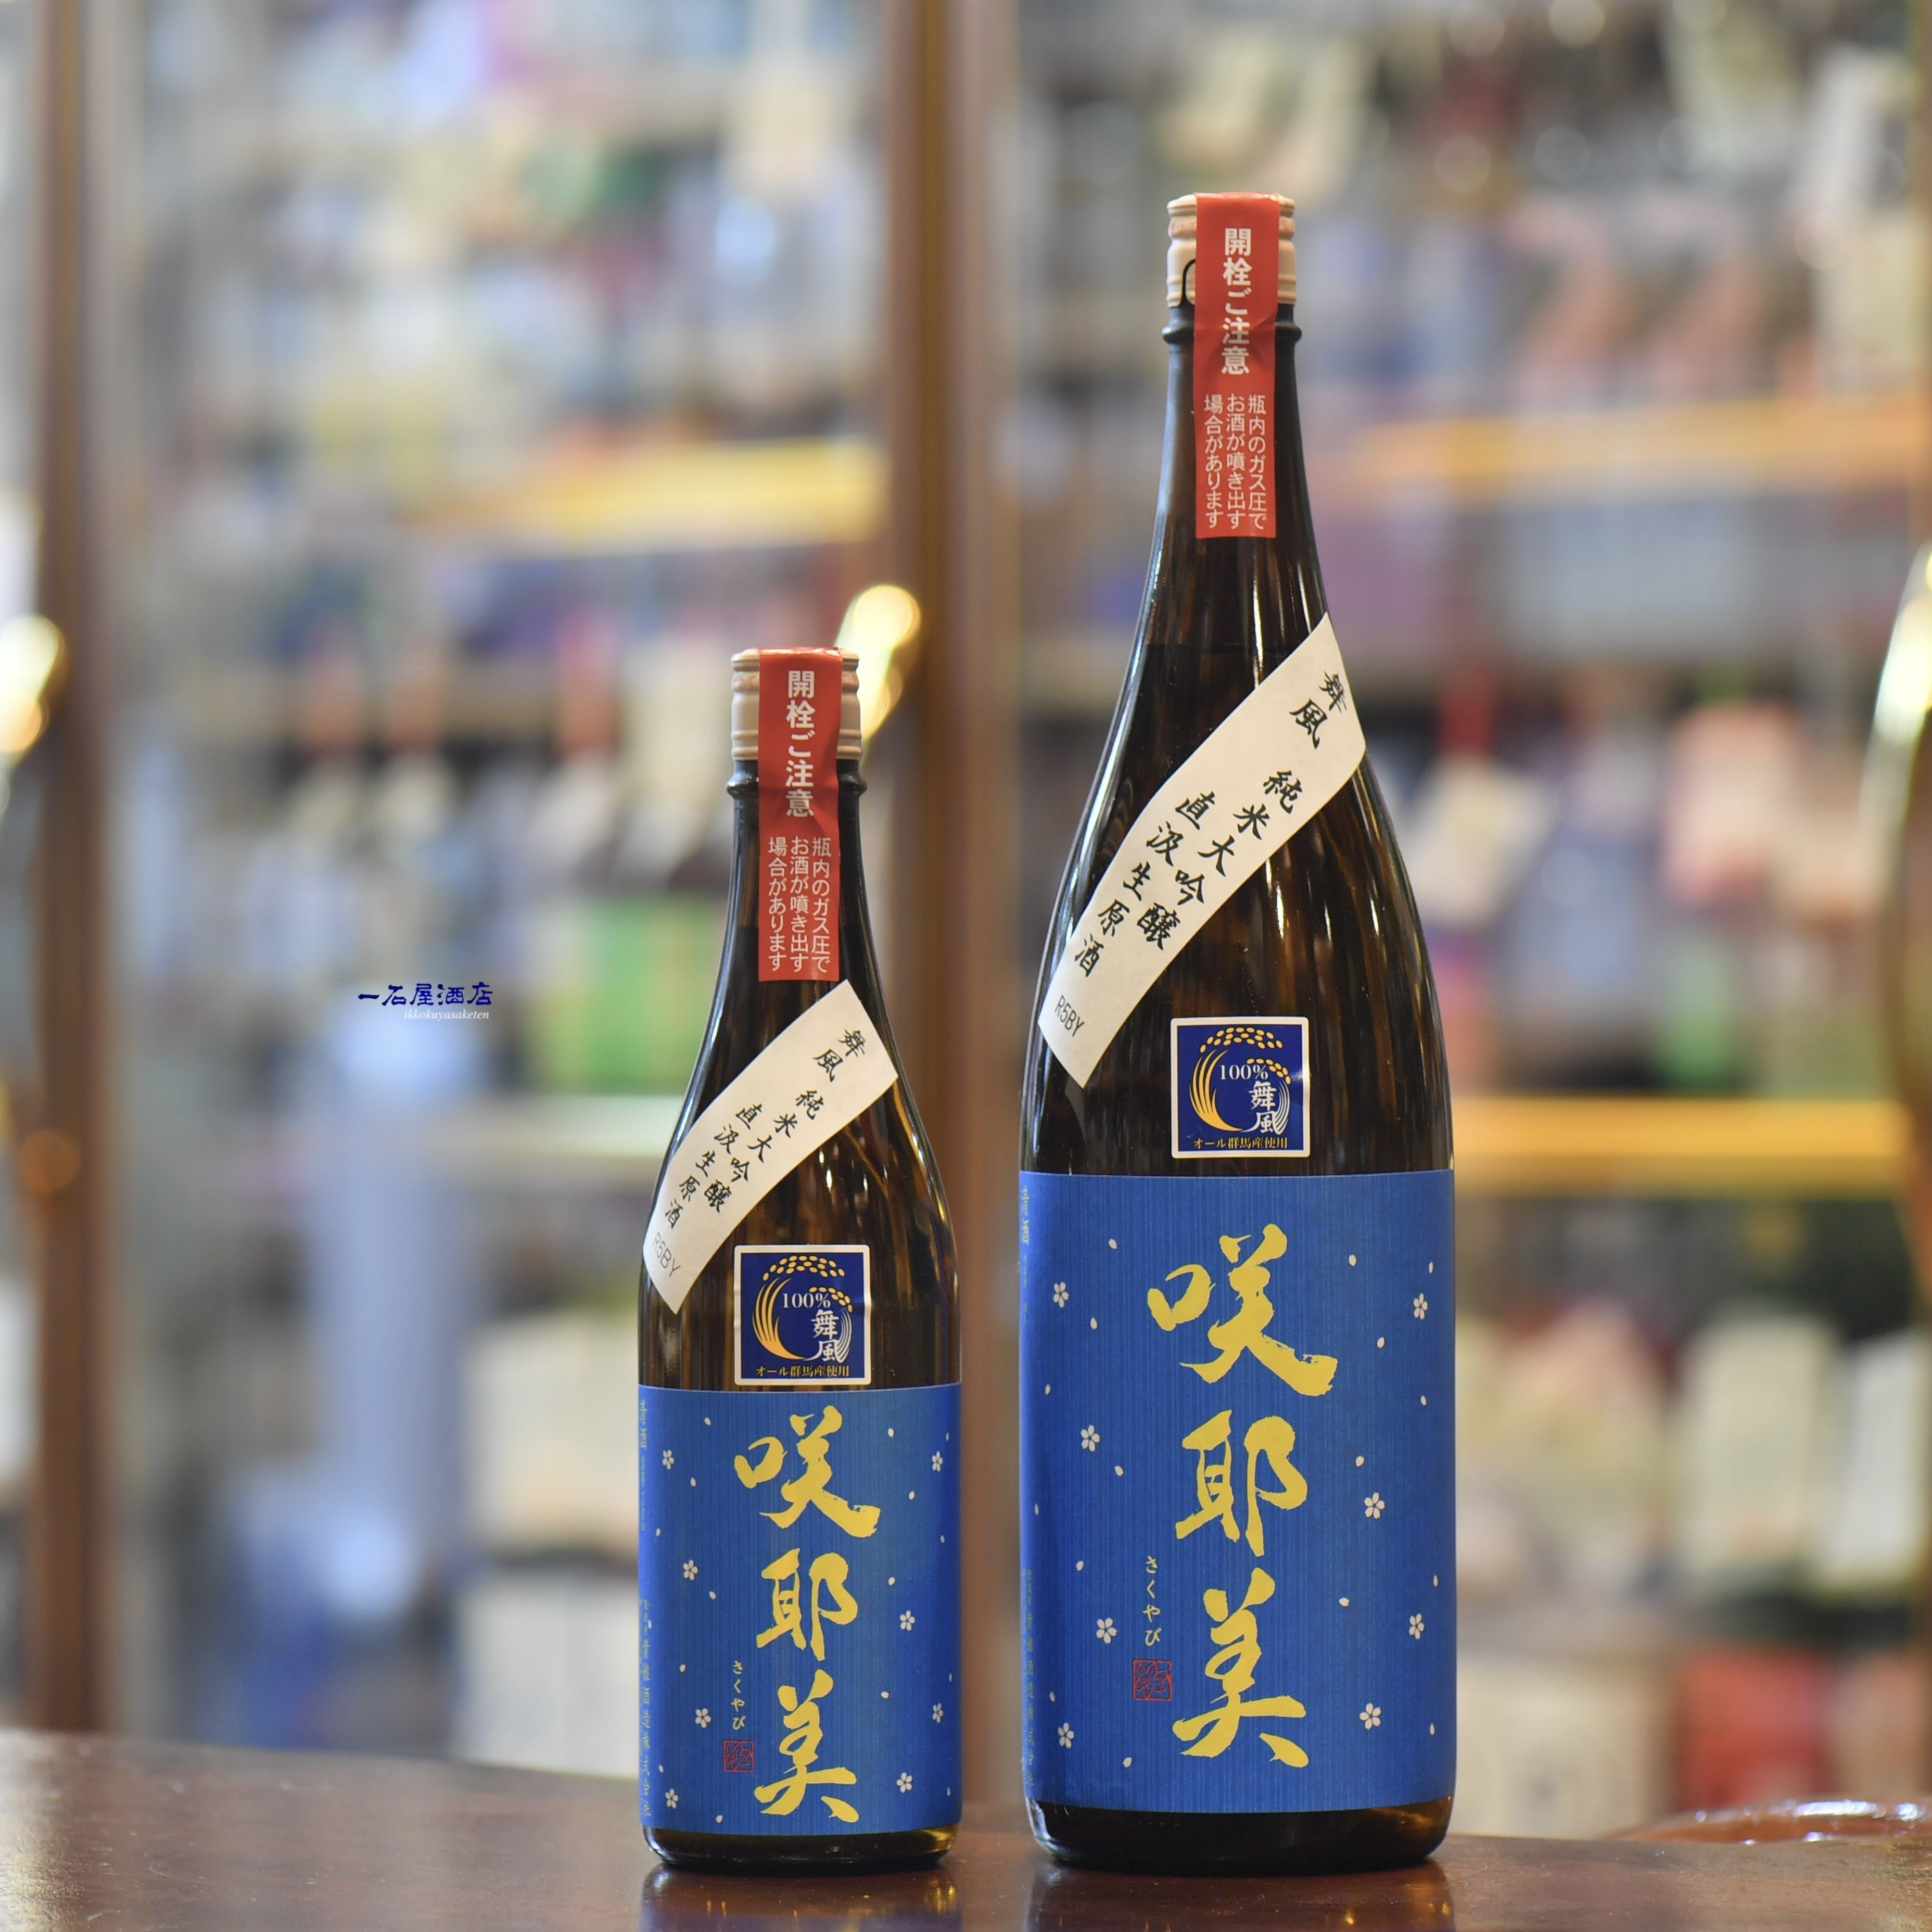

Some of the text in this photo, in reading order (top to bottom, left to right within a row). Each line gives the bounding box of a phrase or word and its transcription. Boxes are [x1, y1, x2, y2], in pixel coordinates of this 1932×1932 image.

[1221, 227, 1253, 375] 開栓ご注意
[1204, 394, 1224, 529] 場合があります
[1226, 393, 1245, 529] お酒が噴き出す
[1248, 394, 1267, 530] 瓶内のガス圧で
[785, 670, 816, 817] 開栓ご注意
[1136, 671, 1349, 951] 舞風 純米大吟醸
[768, 836, 787, 972] 場合があります
[790, 836, 809, 973] お酒が噴き出す
[811, 837, 832, 974] 瓶内のガス圧で
[1074, 791, 1215, 978] 直汲生原酒
[1054, 995, 1085, 1037] R5BY
[1220, 1064, 1268, 1080] 100%
[665, 1103, 763, 1229] 直汲生原酒
[704, 1029, 866, 1213] 舞風 純米大吟醸
[1193, 1137, 1288, 1149] オール群馬産使用
[1248, 1081, 1280, 1135] 舞風
[653, 1232, 681, 1279] R5BY
[783, 1293, 831, 1308] 100%
[756, 1365, 849, 1377] オール群馬産使用
[810, 1309, 842, 1363] 舞風
[1148, 1225, 1338, 1768] 咲耶美
[734, 1406, 880, 1823] 咲耶美
[1143, 1556, 1162, 1646] さくやび
[731, 1660, 746, 1731] さくやび
